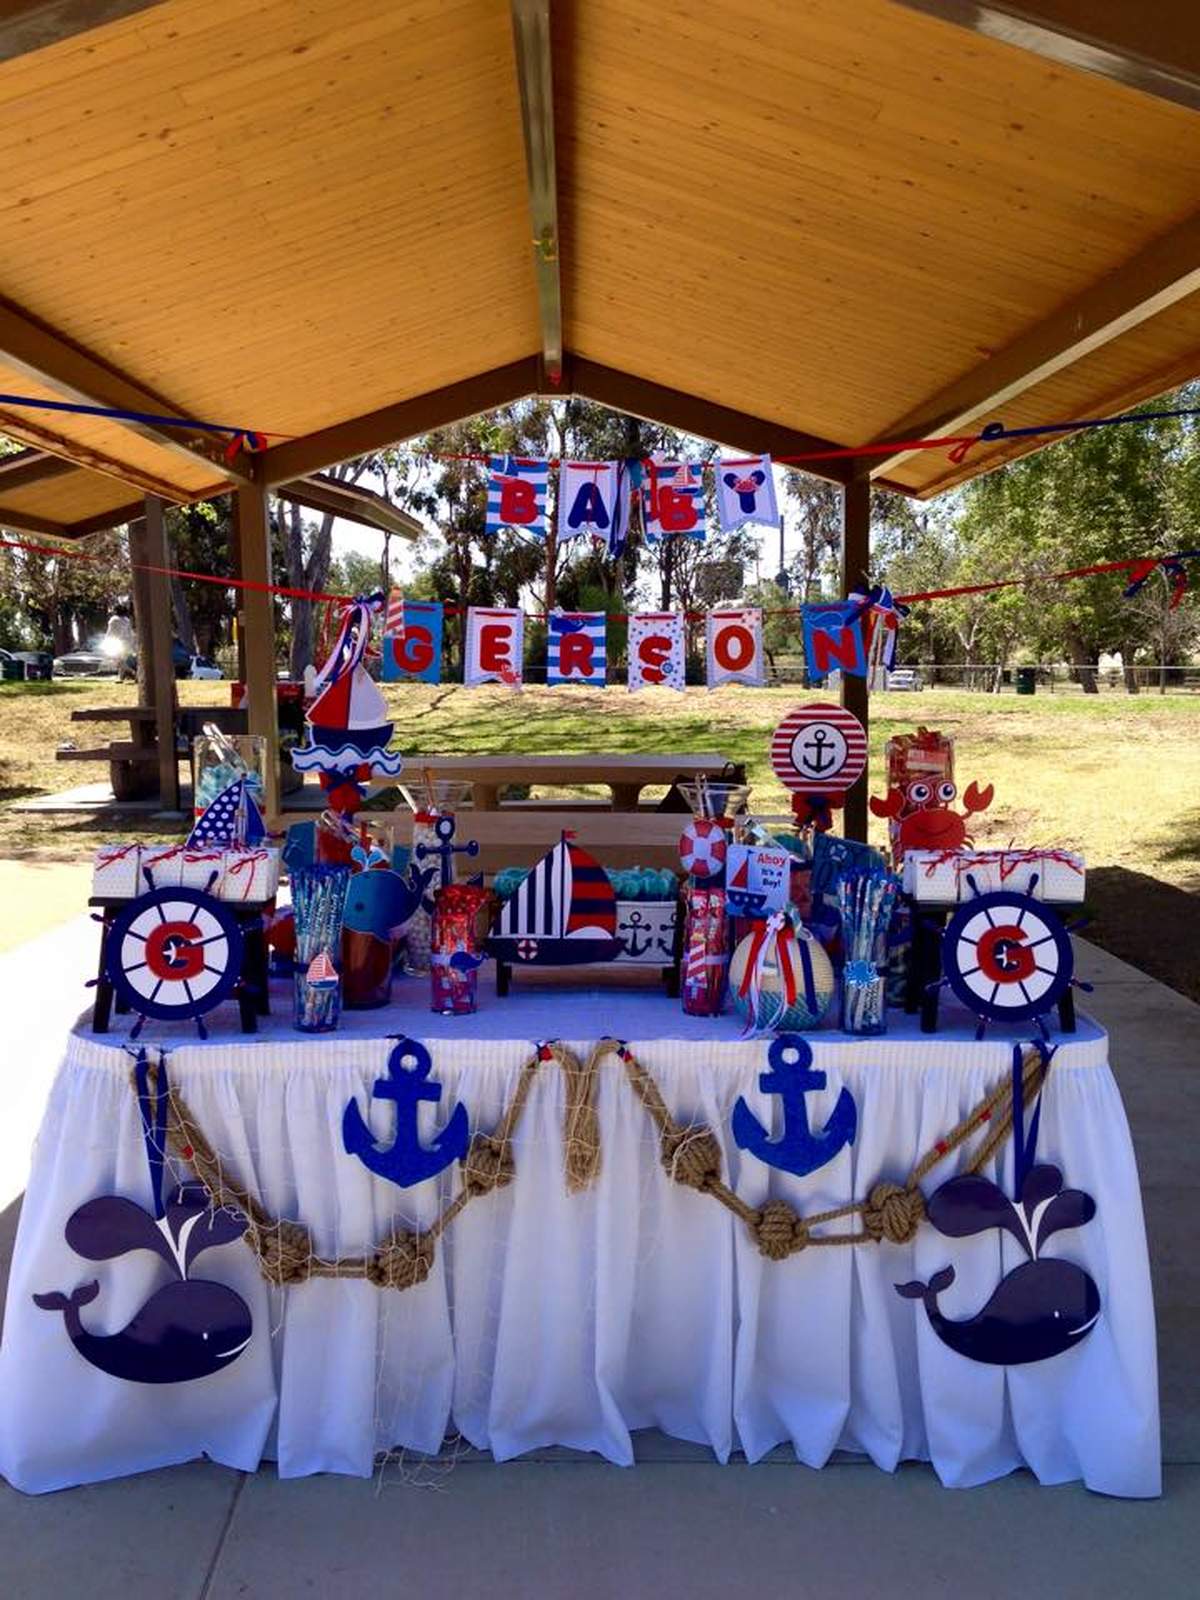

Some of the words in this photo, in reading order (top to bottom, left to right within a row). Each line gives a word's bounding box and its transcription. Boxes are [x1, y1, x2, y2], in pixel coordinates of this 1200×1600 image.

[500, 470, 765, 532] BABY
[392, 624, 859, 682] GERSON
[758, 853, 785, 867] Ahoy
[763, 878, 781, 888] Boy!
[144, 920, 205, 981] G
[975, 924, 1036, 984] G
